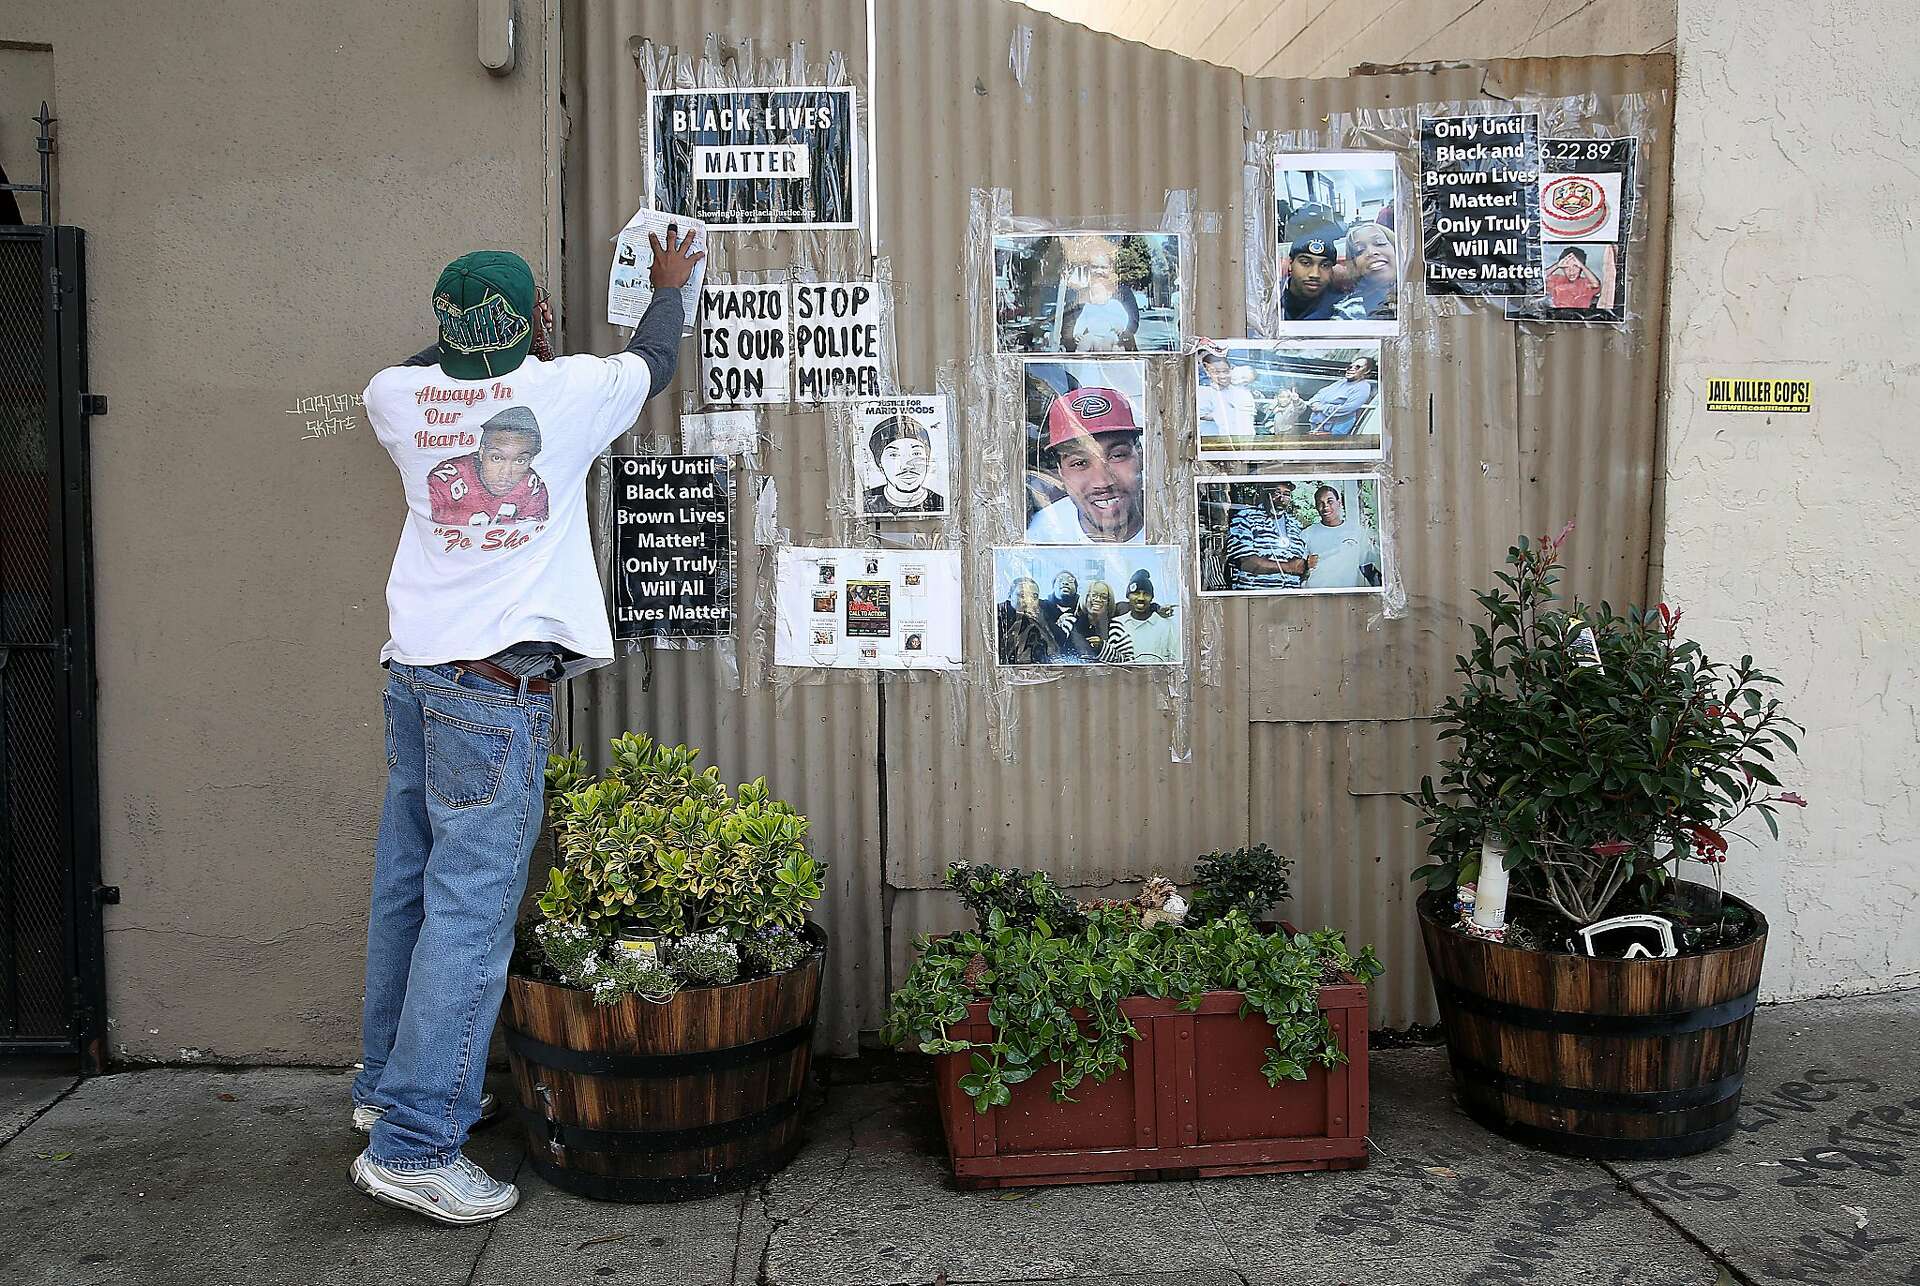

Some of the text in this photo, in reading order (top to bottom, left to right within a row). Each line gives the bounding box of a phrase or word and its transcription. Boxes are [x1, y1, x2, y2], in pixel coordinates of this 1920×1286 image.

[672, 106, 832, 132] BLACK LIVES
[1434, 117, 1525, 140] Only Until
[704, 150, 797, 173] MATTER
[1436, 142, 1524, 162] Black and
[1426, 167, 1537, 186] Brown Lives
[1449, 191, 1518, 209] Matter!
[1436, 214, 1530, 236] Only Truly
[1453, 239, 1518, 257] Will All
[1430, 263, 1541, 281] Lives Matter
[703, 288, 782, 320] MARIO
[799, 286, 870, 319] STOP
[703, 327, 784, 360] IS OUR
[796, 324, 877, 358] POLICE
[709, 366, 764, 399] SON
[799, 365, 881, 397] MURDER
[415, 382, 513, 406] Always In
[1708, 381, 1810, 403] JAIL KILLER COPS!
[424, 408, 462, 425] Our
[414, 430, 476, 448] Hearts
[623, 459, 714, 479] Only Until
[626, 483, 714, 500] Black and
[617, 507, 726, 525] Brown Lives
[638, 532, 705, 549] Matter!
[626, 555, 718, 576] Only Truly
[641, 580, 704, 596] Will All
[618, 605, 730, 622] Lives Matter
